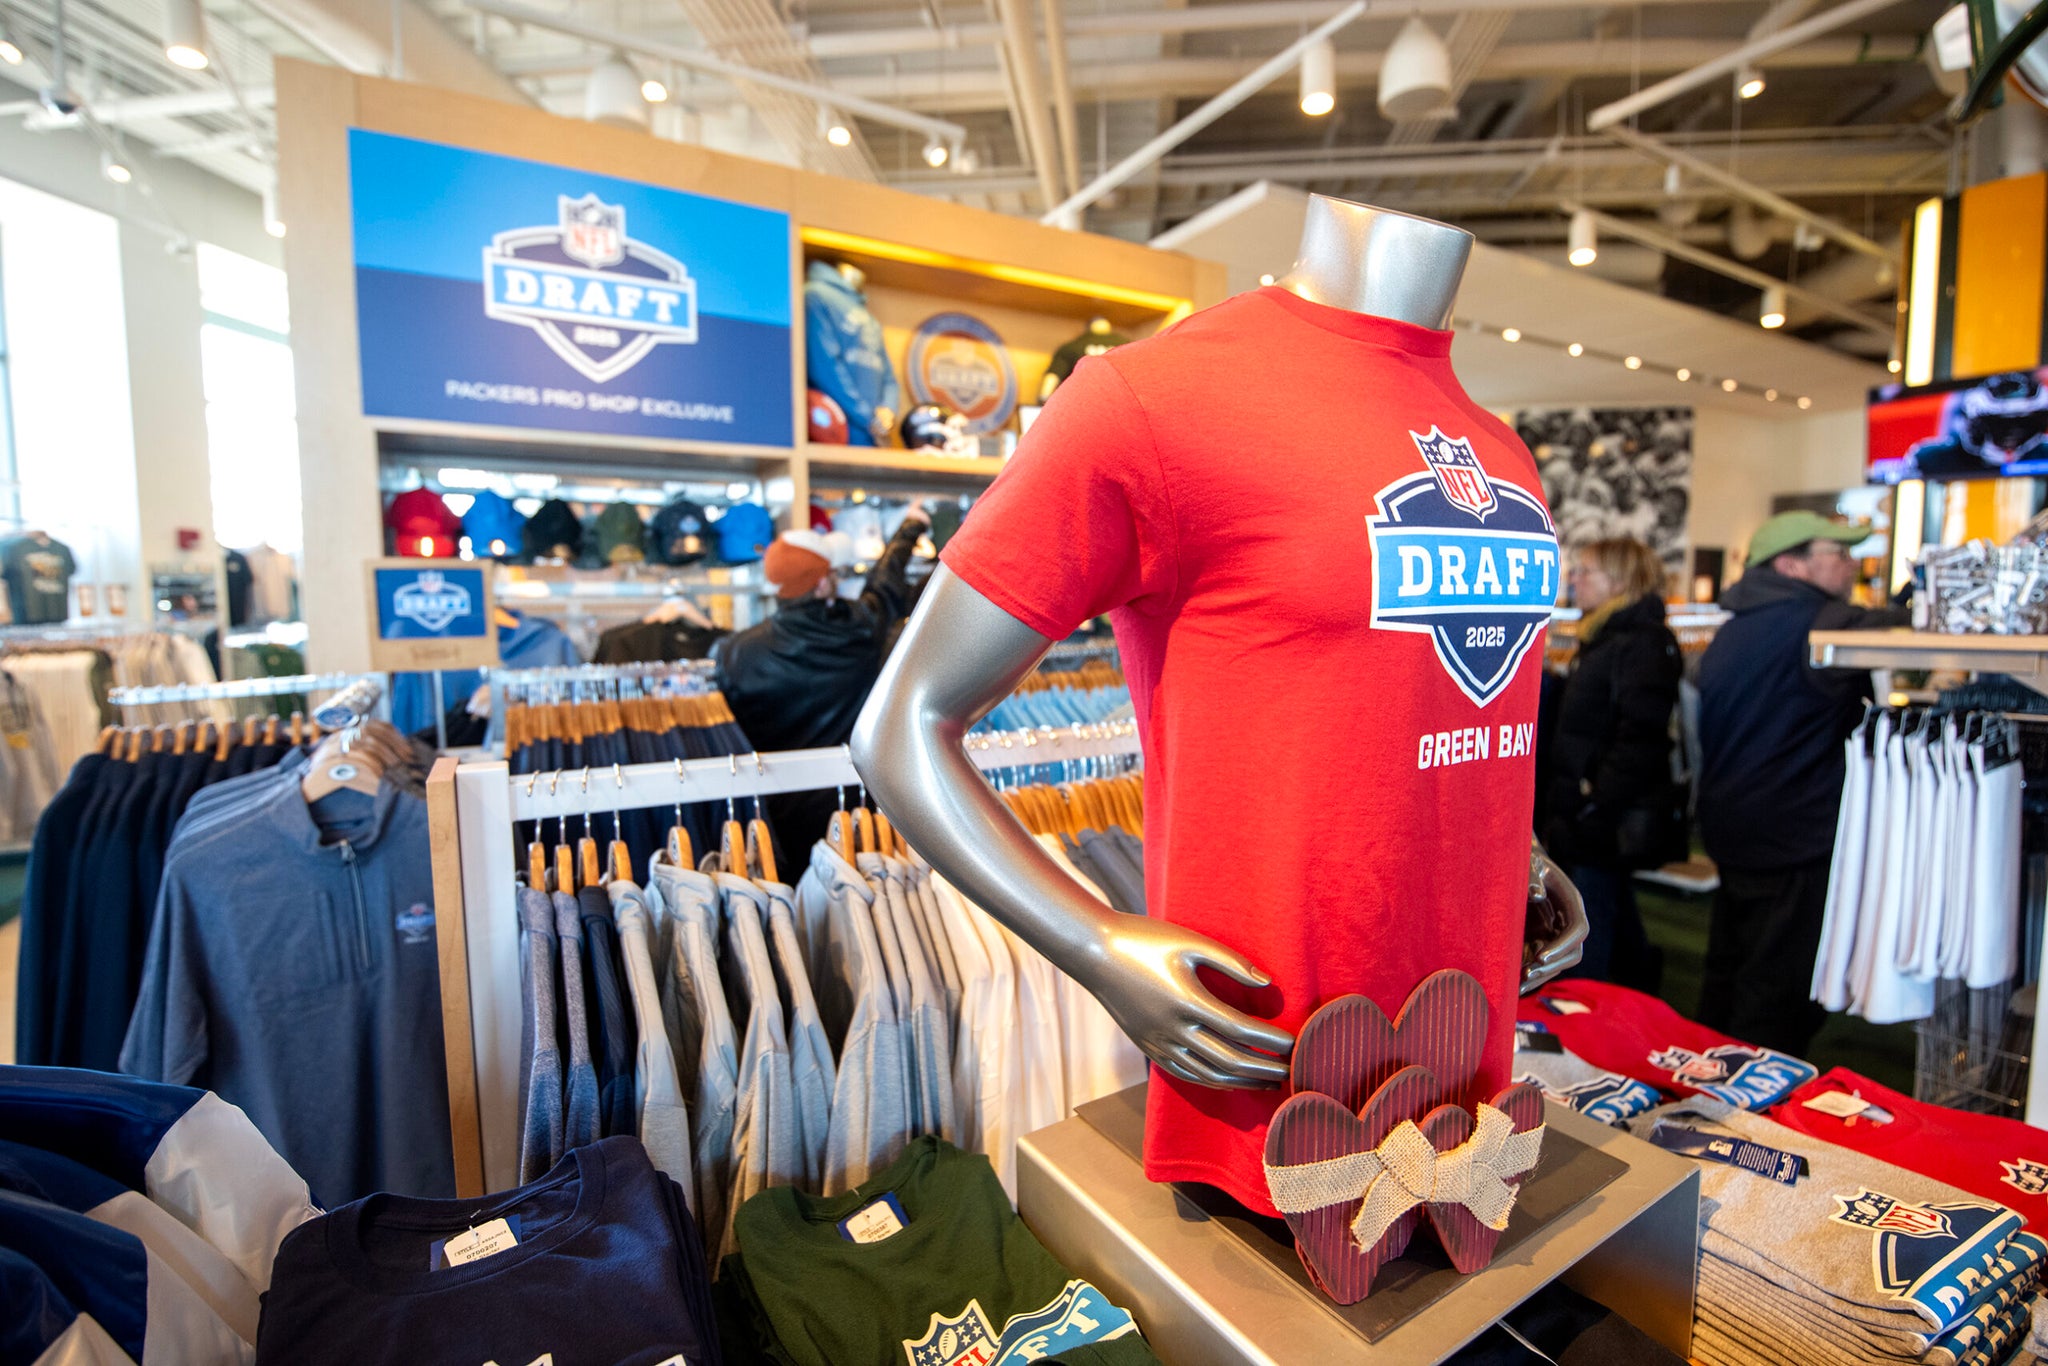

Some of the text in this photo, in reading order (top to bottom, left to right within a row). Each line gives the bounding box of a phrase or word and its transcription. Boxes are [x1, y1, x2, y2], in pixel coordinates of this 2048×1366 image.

[504, 269, 681, 324] DRAFT
[445, 379, 735, 425] PACKERS PRO SHOP EXCLUSIVE
[1438, 466, 1491, 507] NFL
[1397, 544, 1555, 597] DRAFT
[1465, 625, 1506, 649] 2025
[1417, 722, 1534, 771] GREEN BAY
[1877, 1205, 1939, 1233] NFL
